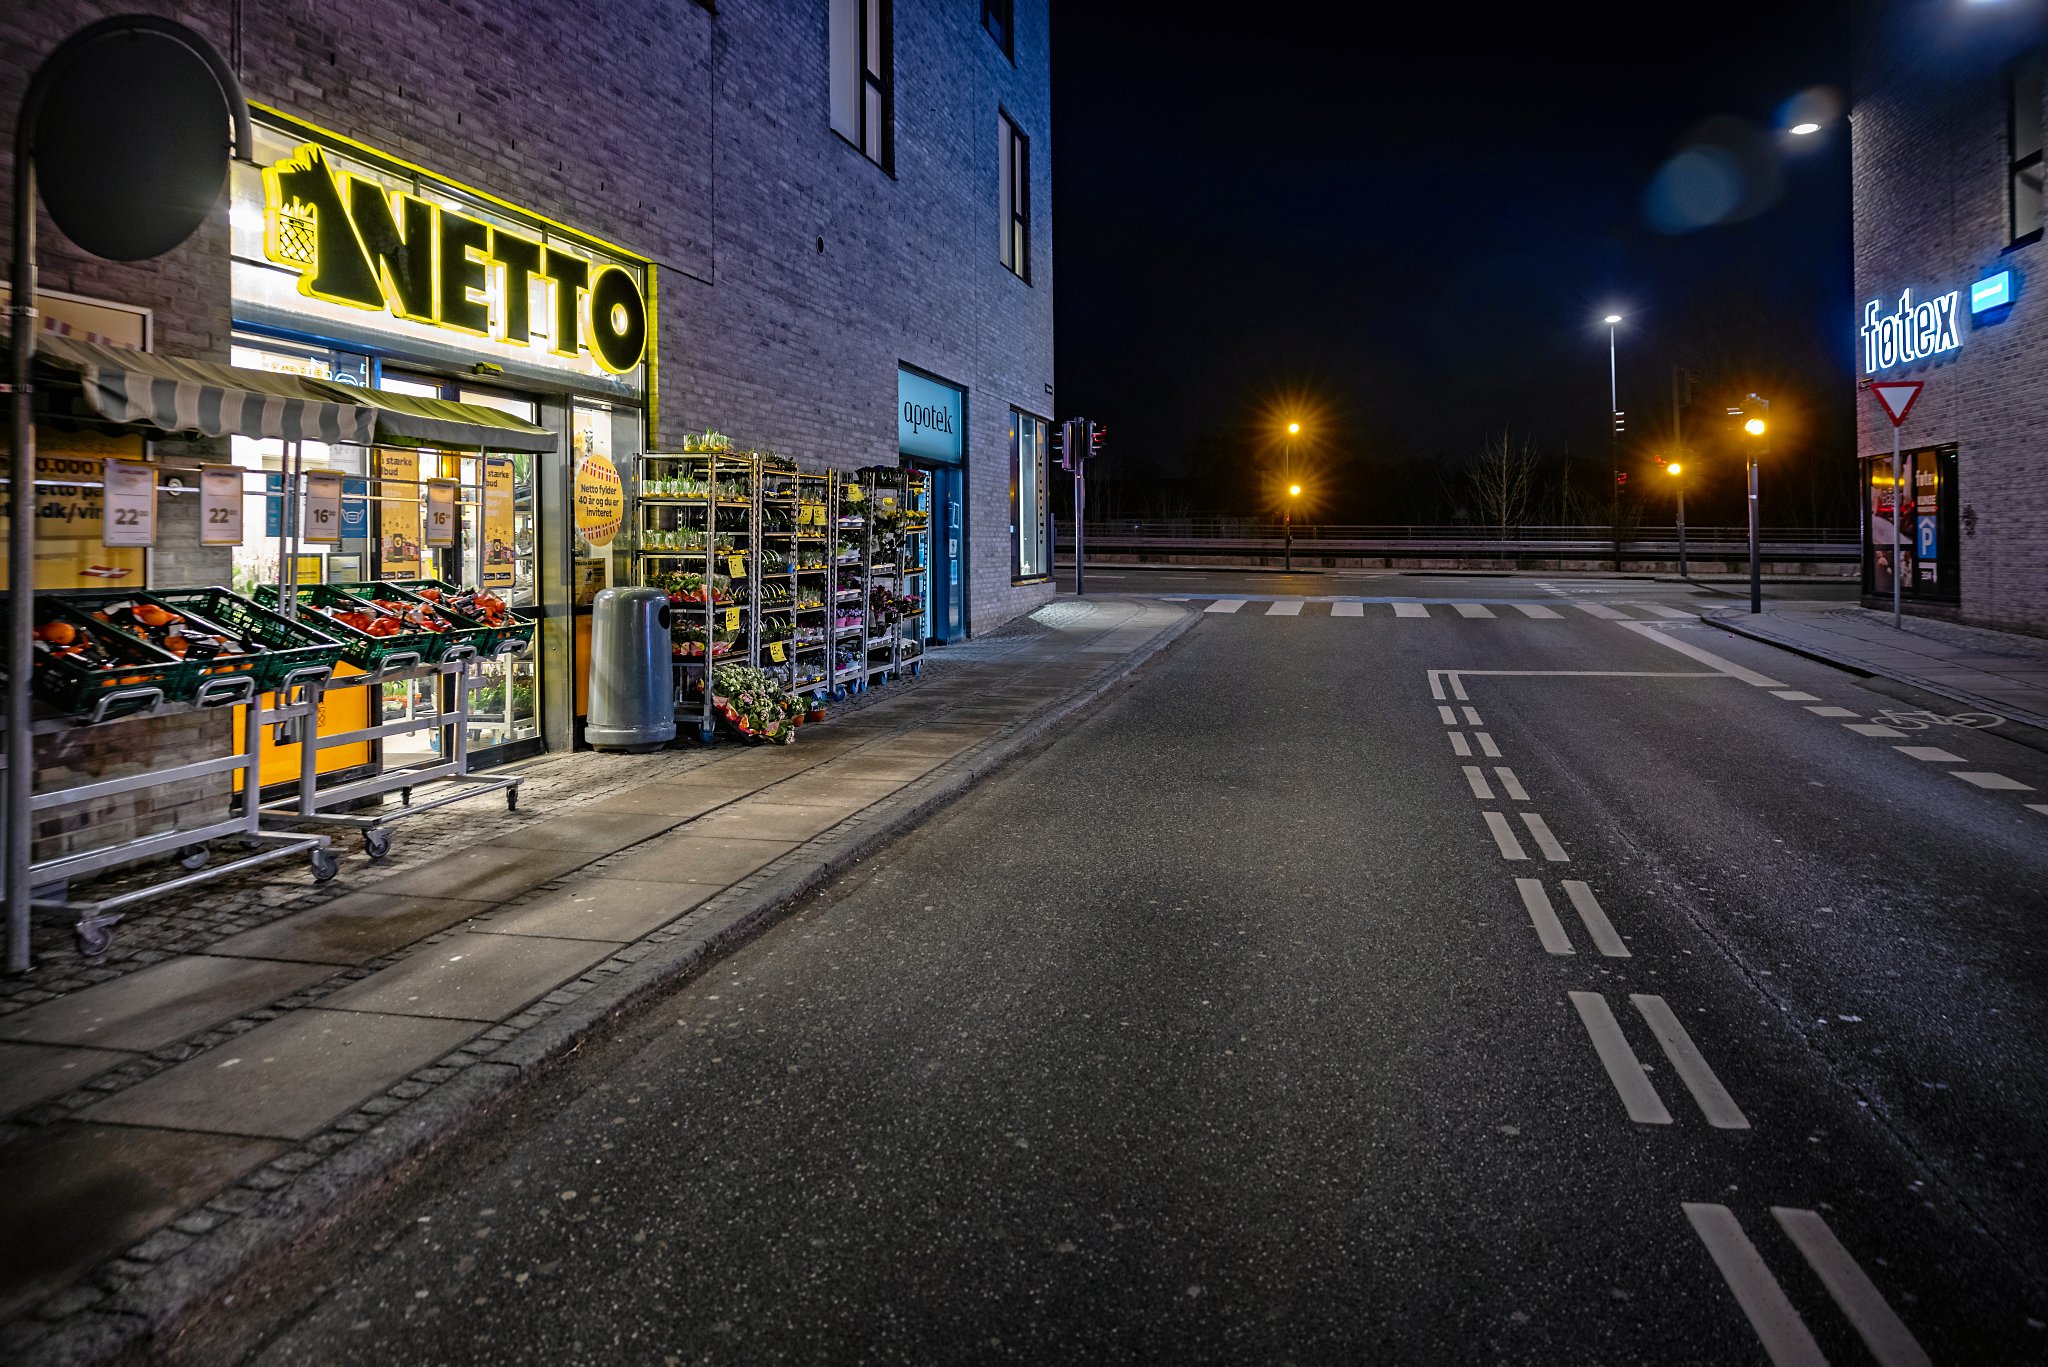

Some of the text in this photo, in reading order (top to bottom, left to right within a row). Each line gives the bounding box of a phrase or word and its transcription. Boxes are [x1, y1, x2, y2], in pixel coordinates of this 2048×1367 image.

[335, 168, 648, 376] NETTO
[1861, 287, 1960, 374] føtex
[904, 401, 953, 434] apotek
[386, 457, 413, 467] stærke
[487, 470, 510, 479] stærke
[581, 484, 616, 495] Netto fylder
[579, 496, 587, 504] 40
[596, 498, 603, 507] og
[604, 497, 612, 506] du
[587, 507, 612, 517] inviteret
[1921, 527, 1933, 556] P
